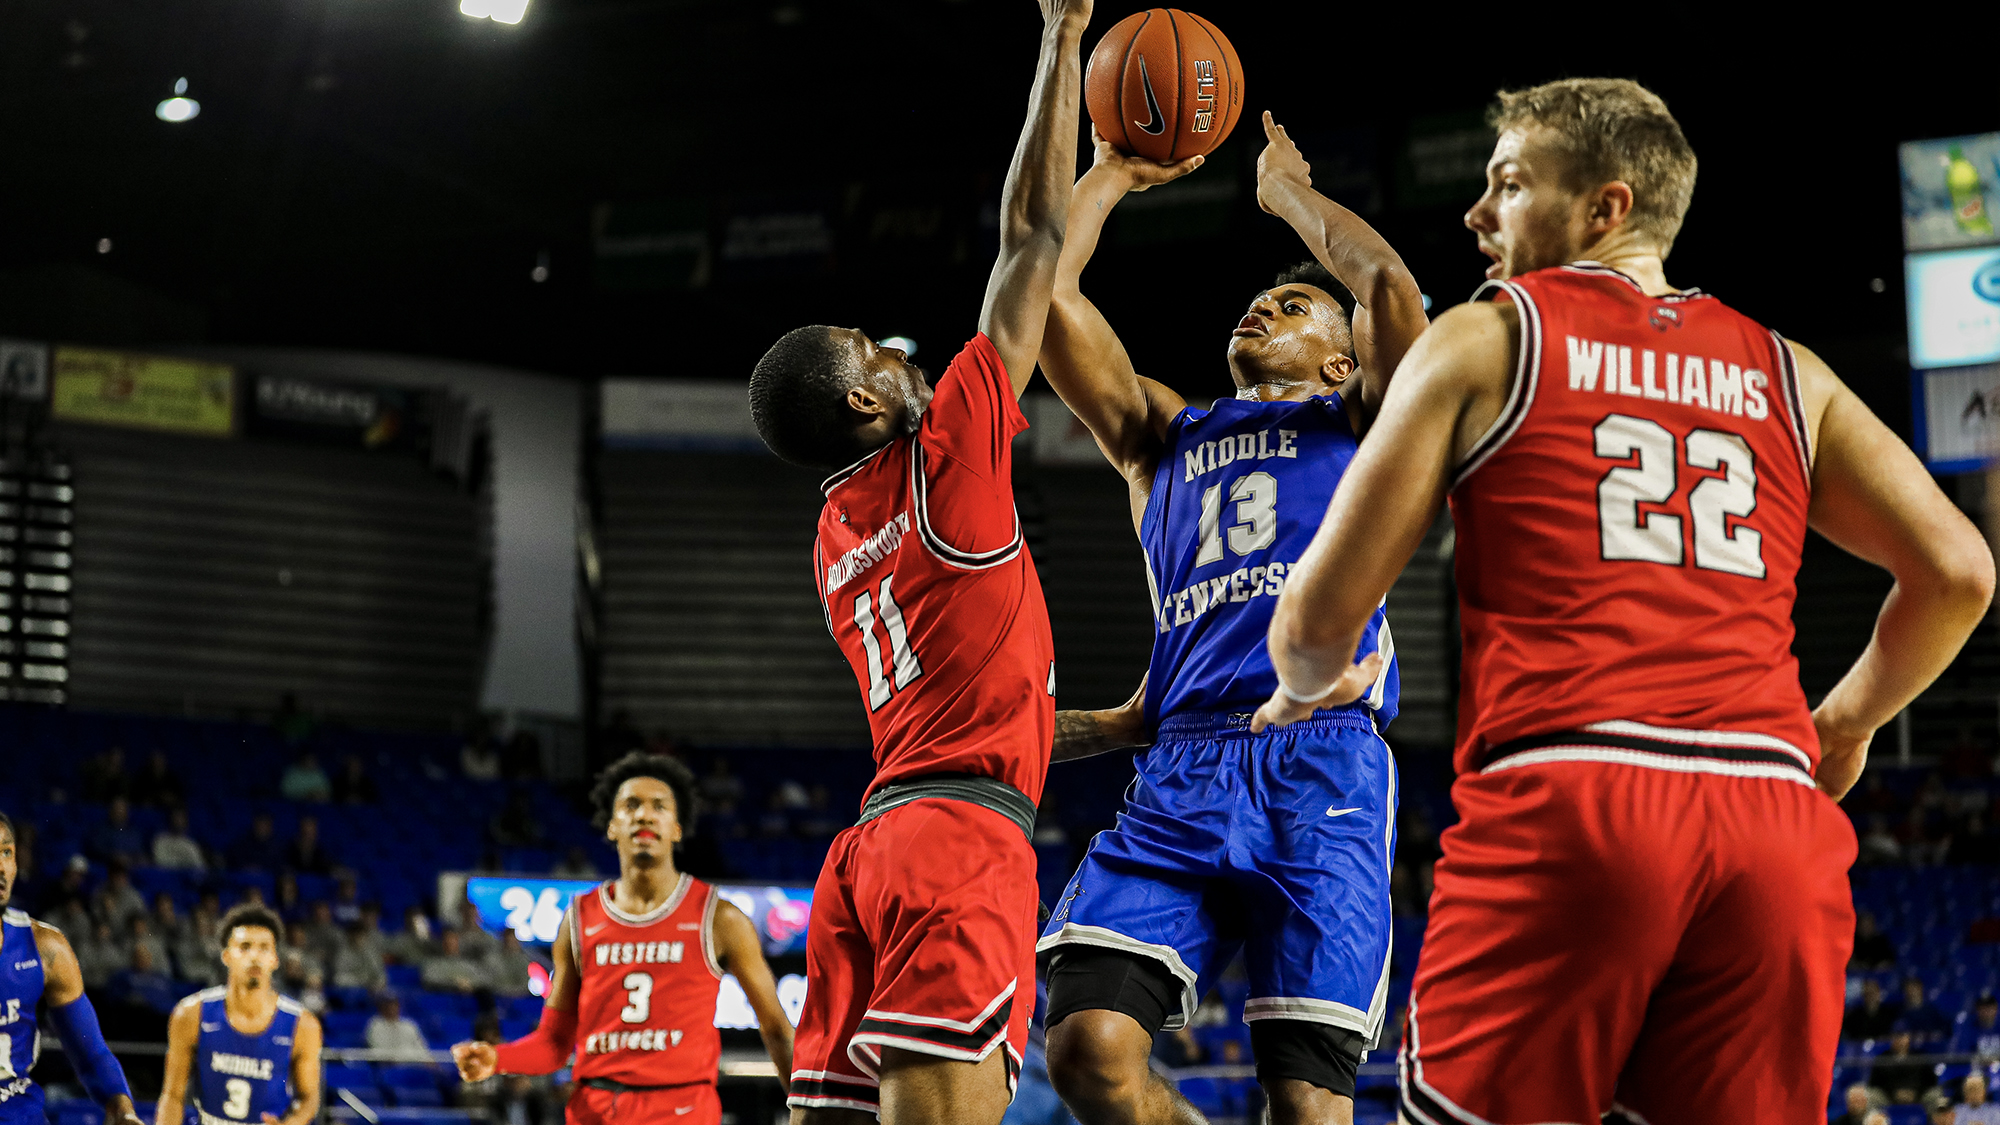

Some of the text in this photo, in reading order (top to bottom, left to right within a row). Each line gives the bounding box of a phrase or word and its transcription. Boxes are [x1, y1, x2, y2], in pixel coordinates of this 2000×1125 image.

[1192, 60, 1214, 132] ELITE
[1565, 334, 1769, 421] WILLIAMS
[1184, 429, 1298, 483] MIDDLE
[1195, 471, 1278, 569] 13
[1593, 413, 1766, 580] 22
[1157, 561, 1297, 635] TENNESS
[853, 571, 925, 715] 11
[595, 941, 685, 967] WESTERN
[620, 972, 653, 1024] 3
[585, 1029, 684, 1055] KENTUCKY
[223, 1078, 252, 1119] 3
